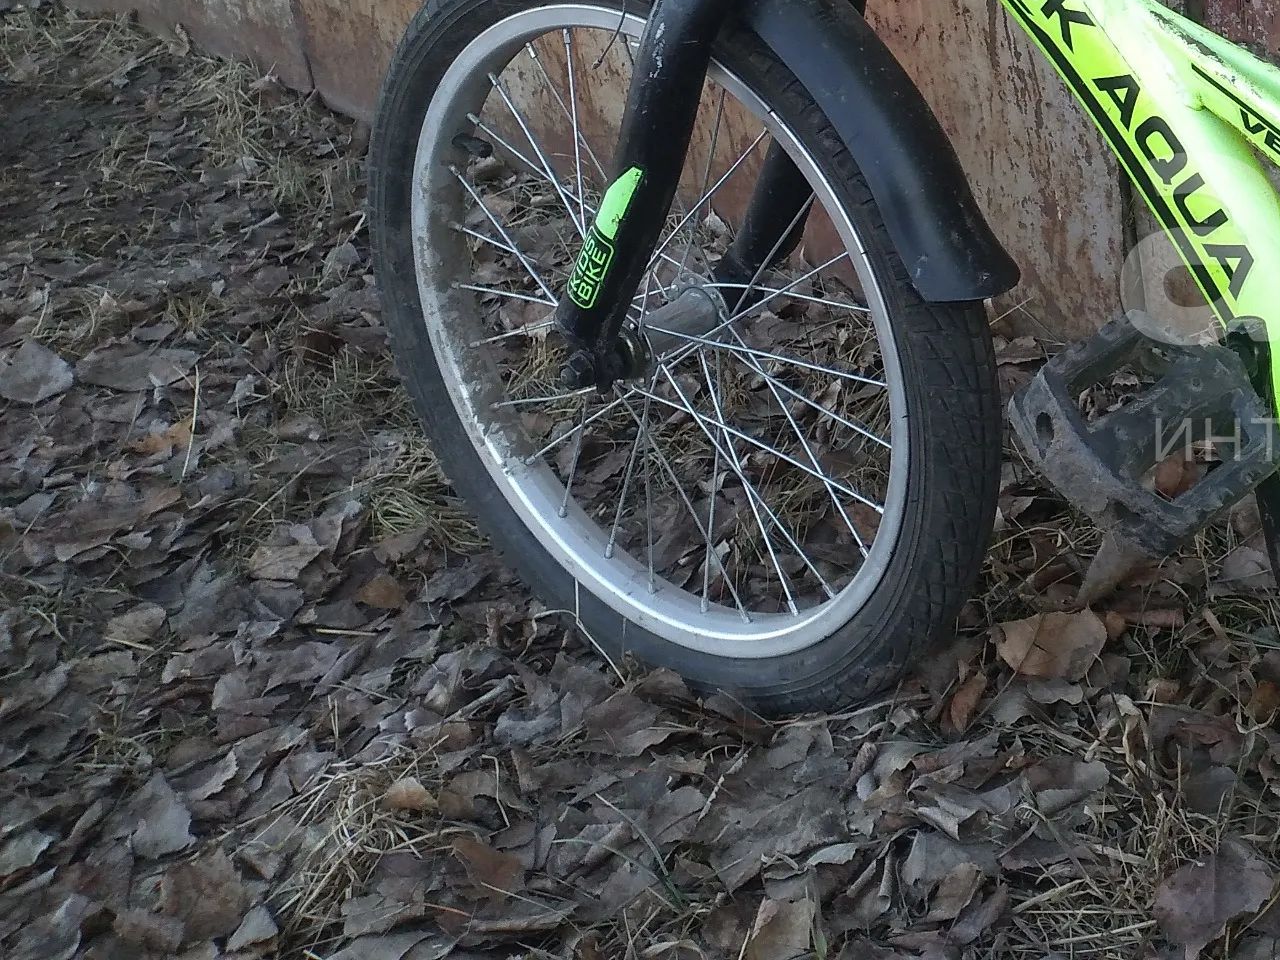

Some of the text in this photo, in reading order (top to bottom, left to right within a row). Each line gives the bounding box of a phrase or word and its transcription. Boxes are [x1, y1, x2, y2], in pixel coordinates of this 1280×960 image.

[1094, 74, 1255, 301] AQUA
[570, 235, 597, 291] KIDS
[578, 249, 607, 300] BIKE
